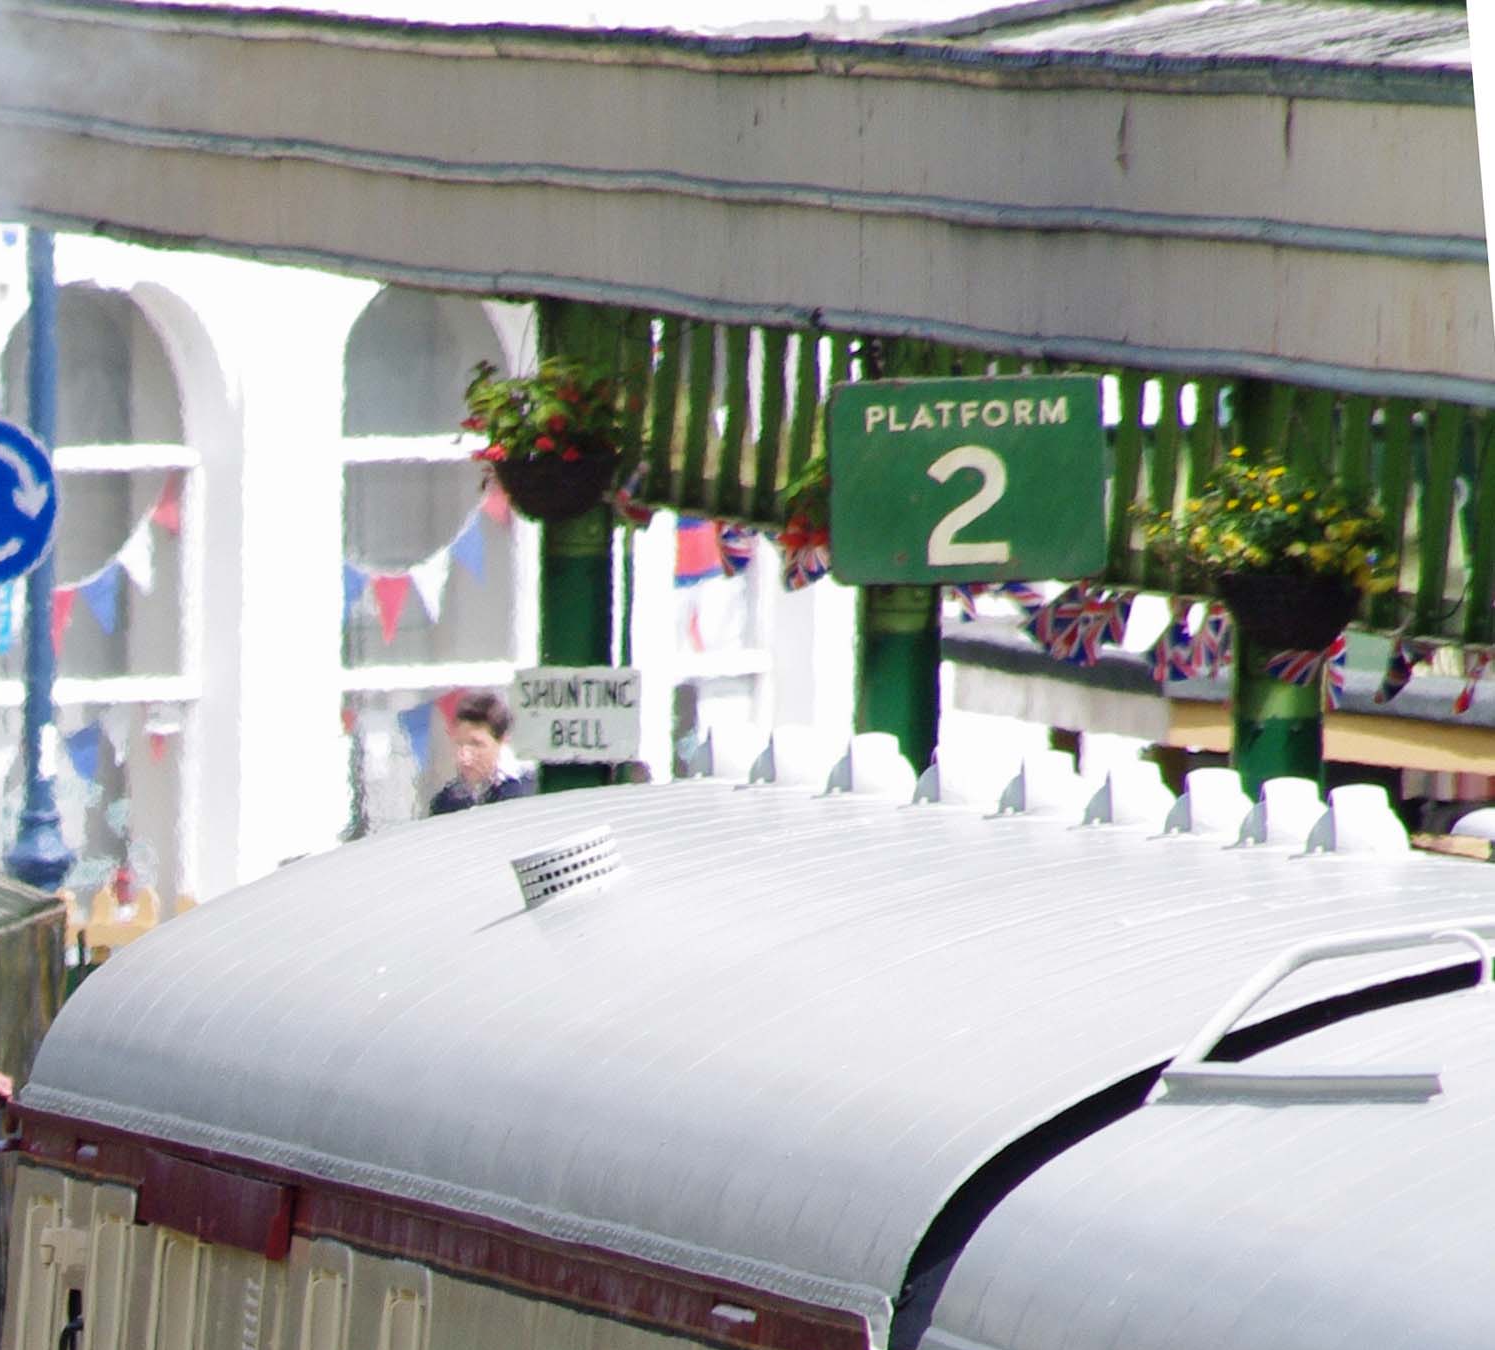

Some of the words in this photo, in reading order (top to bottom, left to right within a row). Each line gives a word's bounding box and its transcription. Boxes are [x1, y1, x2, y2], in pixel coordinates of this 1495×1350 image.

[865, 396, 1068, 433] PLATFORM
[927, 445, 1011, 567] 2
[521, 678, 635, 709] SHUNTING
[551, 719, 609, 749] BELL
